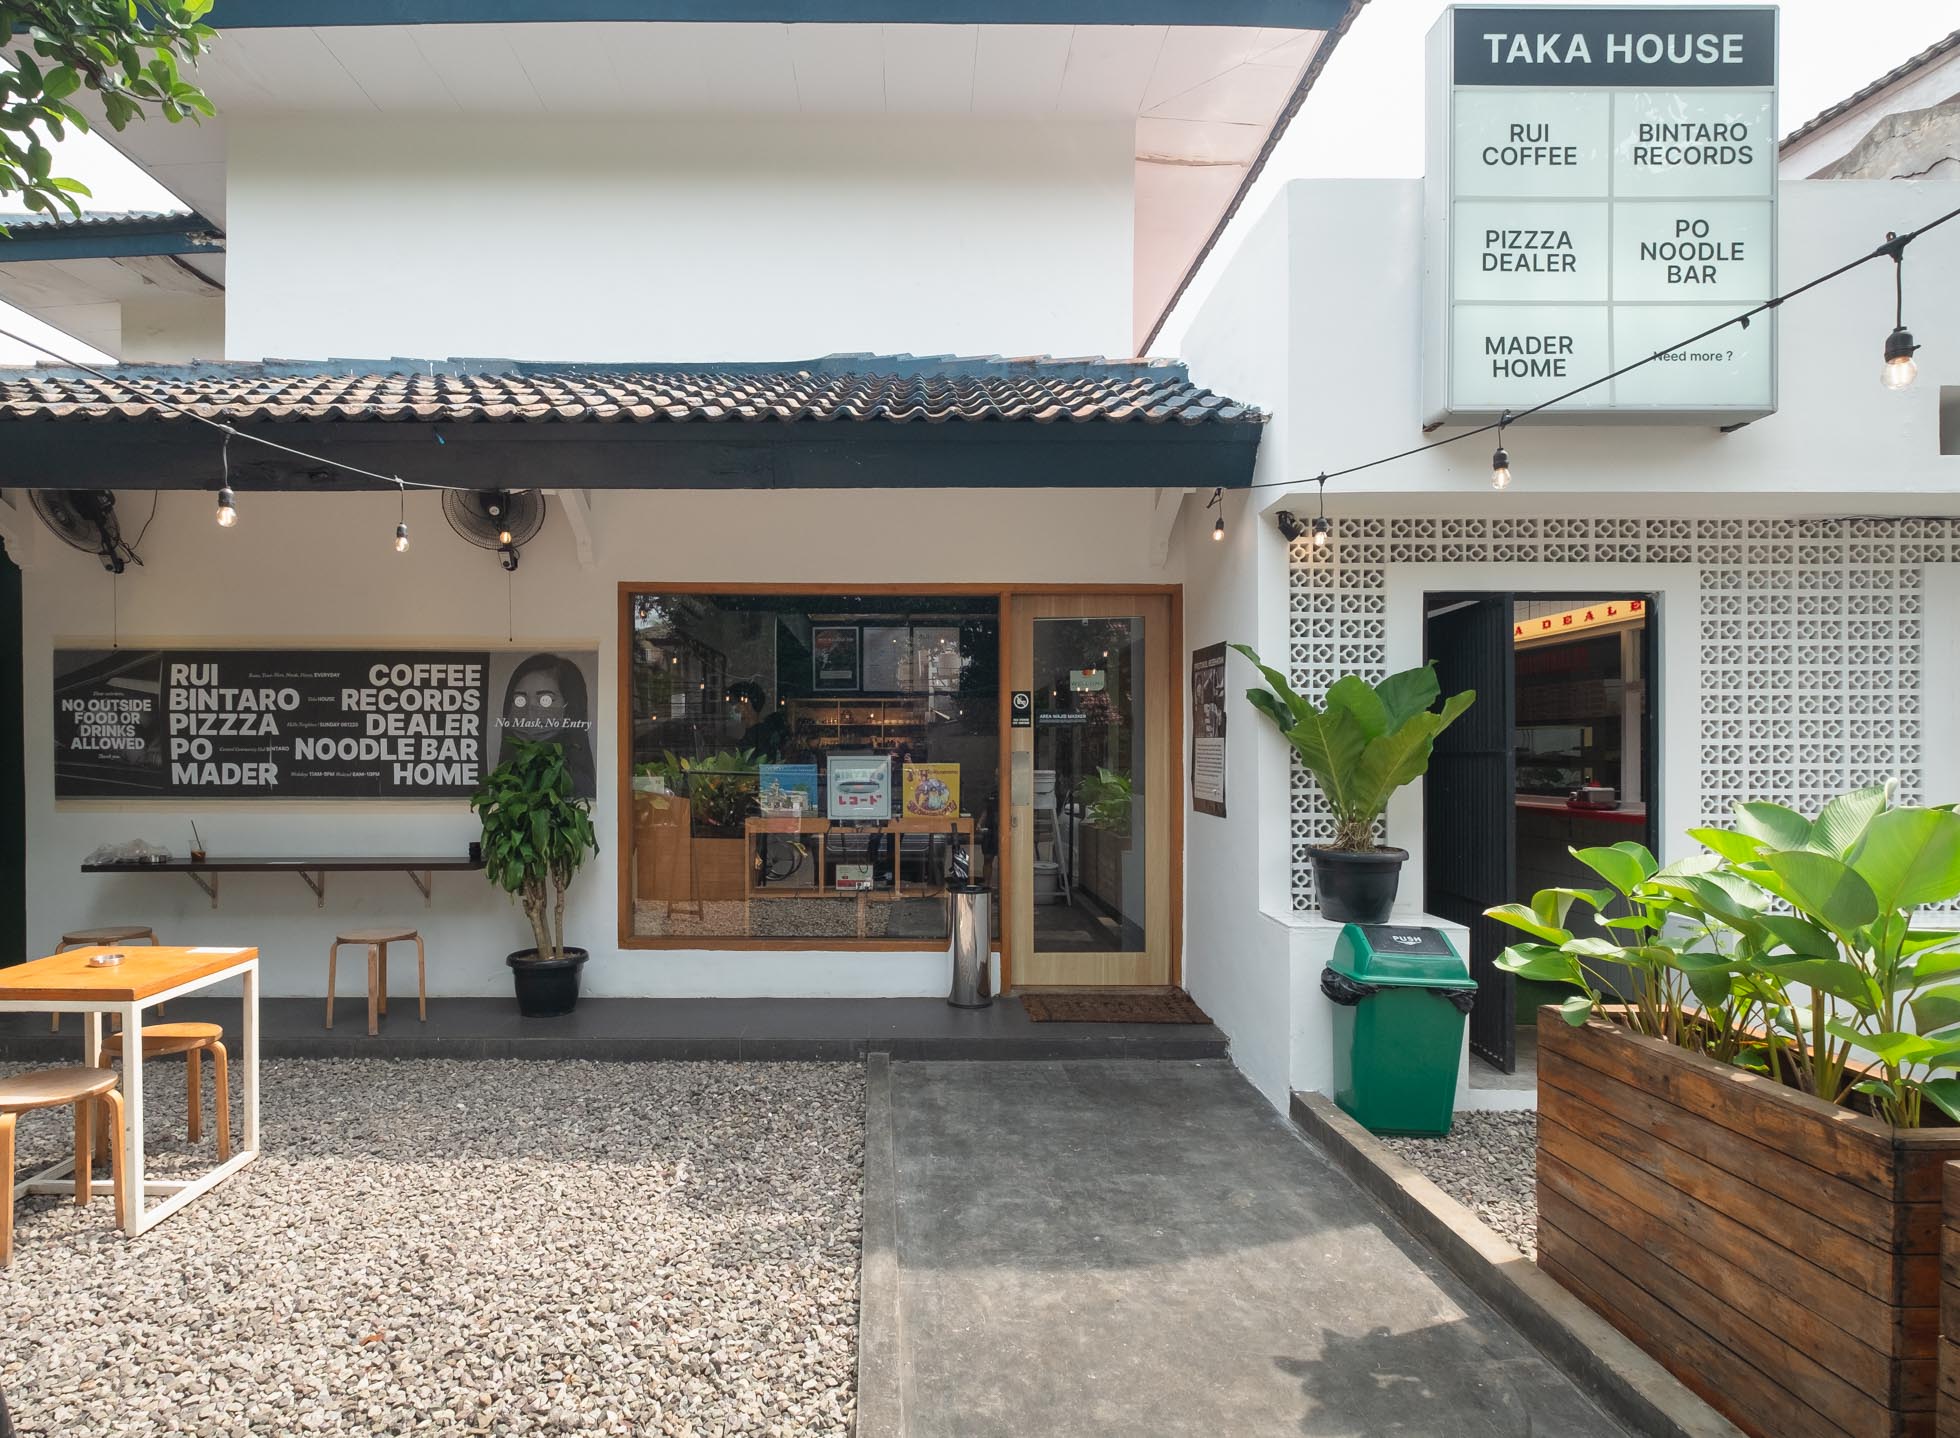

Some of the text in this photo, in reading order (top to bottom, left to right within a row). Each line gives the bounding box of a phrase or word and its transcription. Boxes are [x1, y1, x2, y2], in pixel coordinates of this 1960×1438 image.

[1484, 33, 1744, 64] TAKA HOUSE
[1510, 123, 1549, 142] RUI
[1639, 123, 1748, 142] BINTARO
[1483, 147, 1577, 165] COFFEE
[1633, 146, 1753, 165] RECORDS
[1675, 219, 1710, 238] PO
[1485, 230, 1573, 249] PIZZZA
[1640, 242, 1744, 261] NOODLE
[1482, 253, 1576, 272] DEALER
[1667, 265, 1717, 284] BAR
[1485, 336, 1573, 355] MADER
[1653, 350, 1733, 361] Need more ?
[1492, 359, 1567, 378] HOME
[171, 664, 219, 686] RUI
[369, 664, 481, 686] COFFEE
[62, 699, 152, 712] NO OUTSIDE
[169, 688, 300, 711] BINTARO
[341, 688, 480, 711] RECORDS
[74, 712, 140, 724] FOOD OR
[170, 713, 280, 736] PIZZZA
[366, 714, 480, 736] DEALER
[495, 717, 592, 732] No Mask, No Entry
[80, 724, 136, 737] DRINKS
[70, 737, 145, 750] ALLOWED
[171, 738, 213, 760] PO
[295, 738, 479, 761] NOODLE BAR
[171, 762, 279, 785] MADER
[394, 763, 480, 786] HOME
[1391, 935, 1422, 943] PUSH
